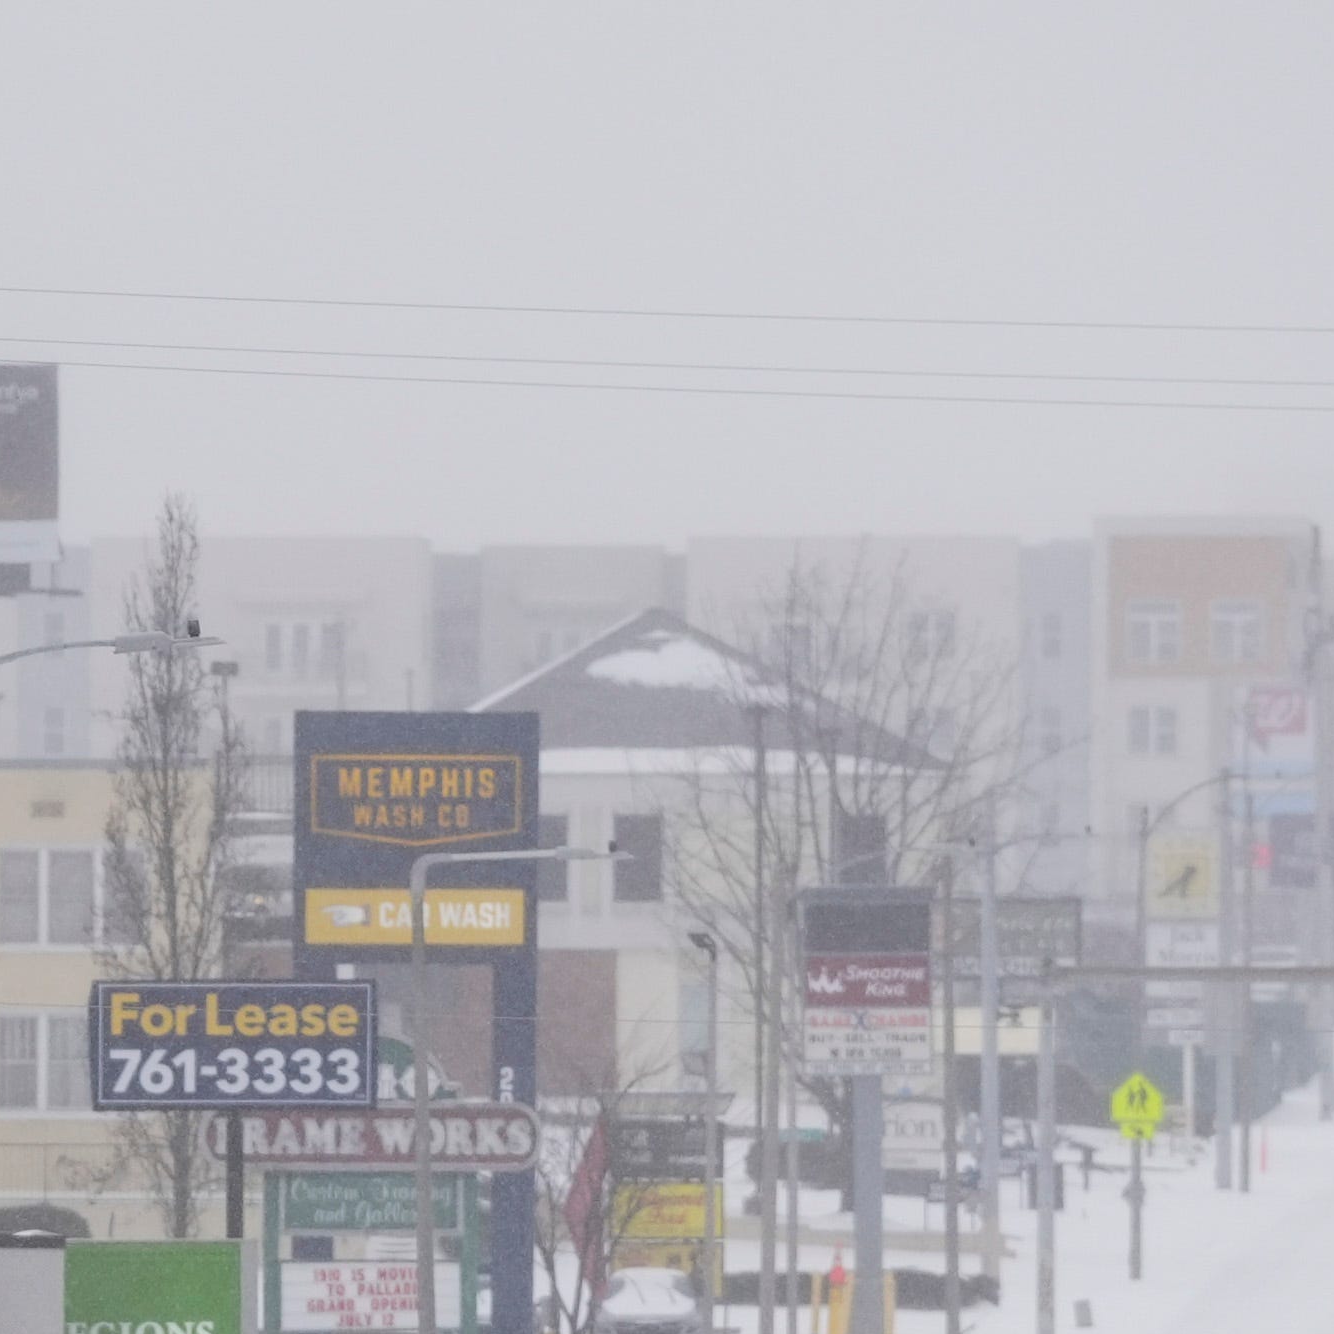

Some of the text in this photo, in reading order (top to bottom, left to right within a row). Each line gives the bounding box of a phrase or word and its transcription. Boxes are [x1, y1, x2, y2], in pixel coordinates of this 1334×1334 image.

[339, 767, 497, 798] MEMPHIS
[353, 804, 470, 828] WASH CO
[439, 901, 511, 928] WASH
[110, 993, 359, 1037] For Lease
[109, 1047, 360, 1094] 761-3333
[377, 1267, 417, 1281] MOVI
[357, 1283, 417, 1296] PALLADI
[371, 1298, 417, 1311] OPENI
